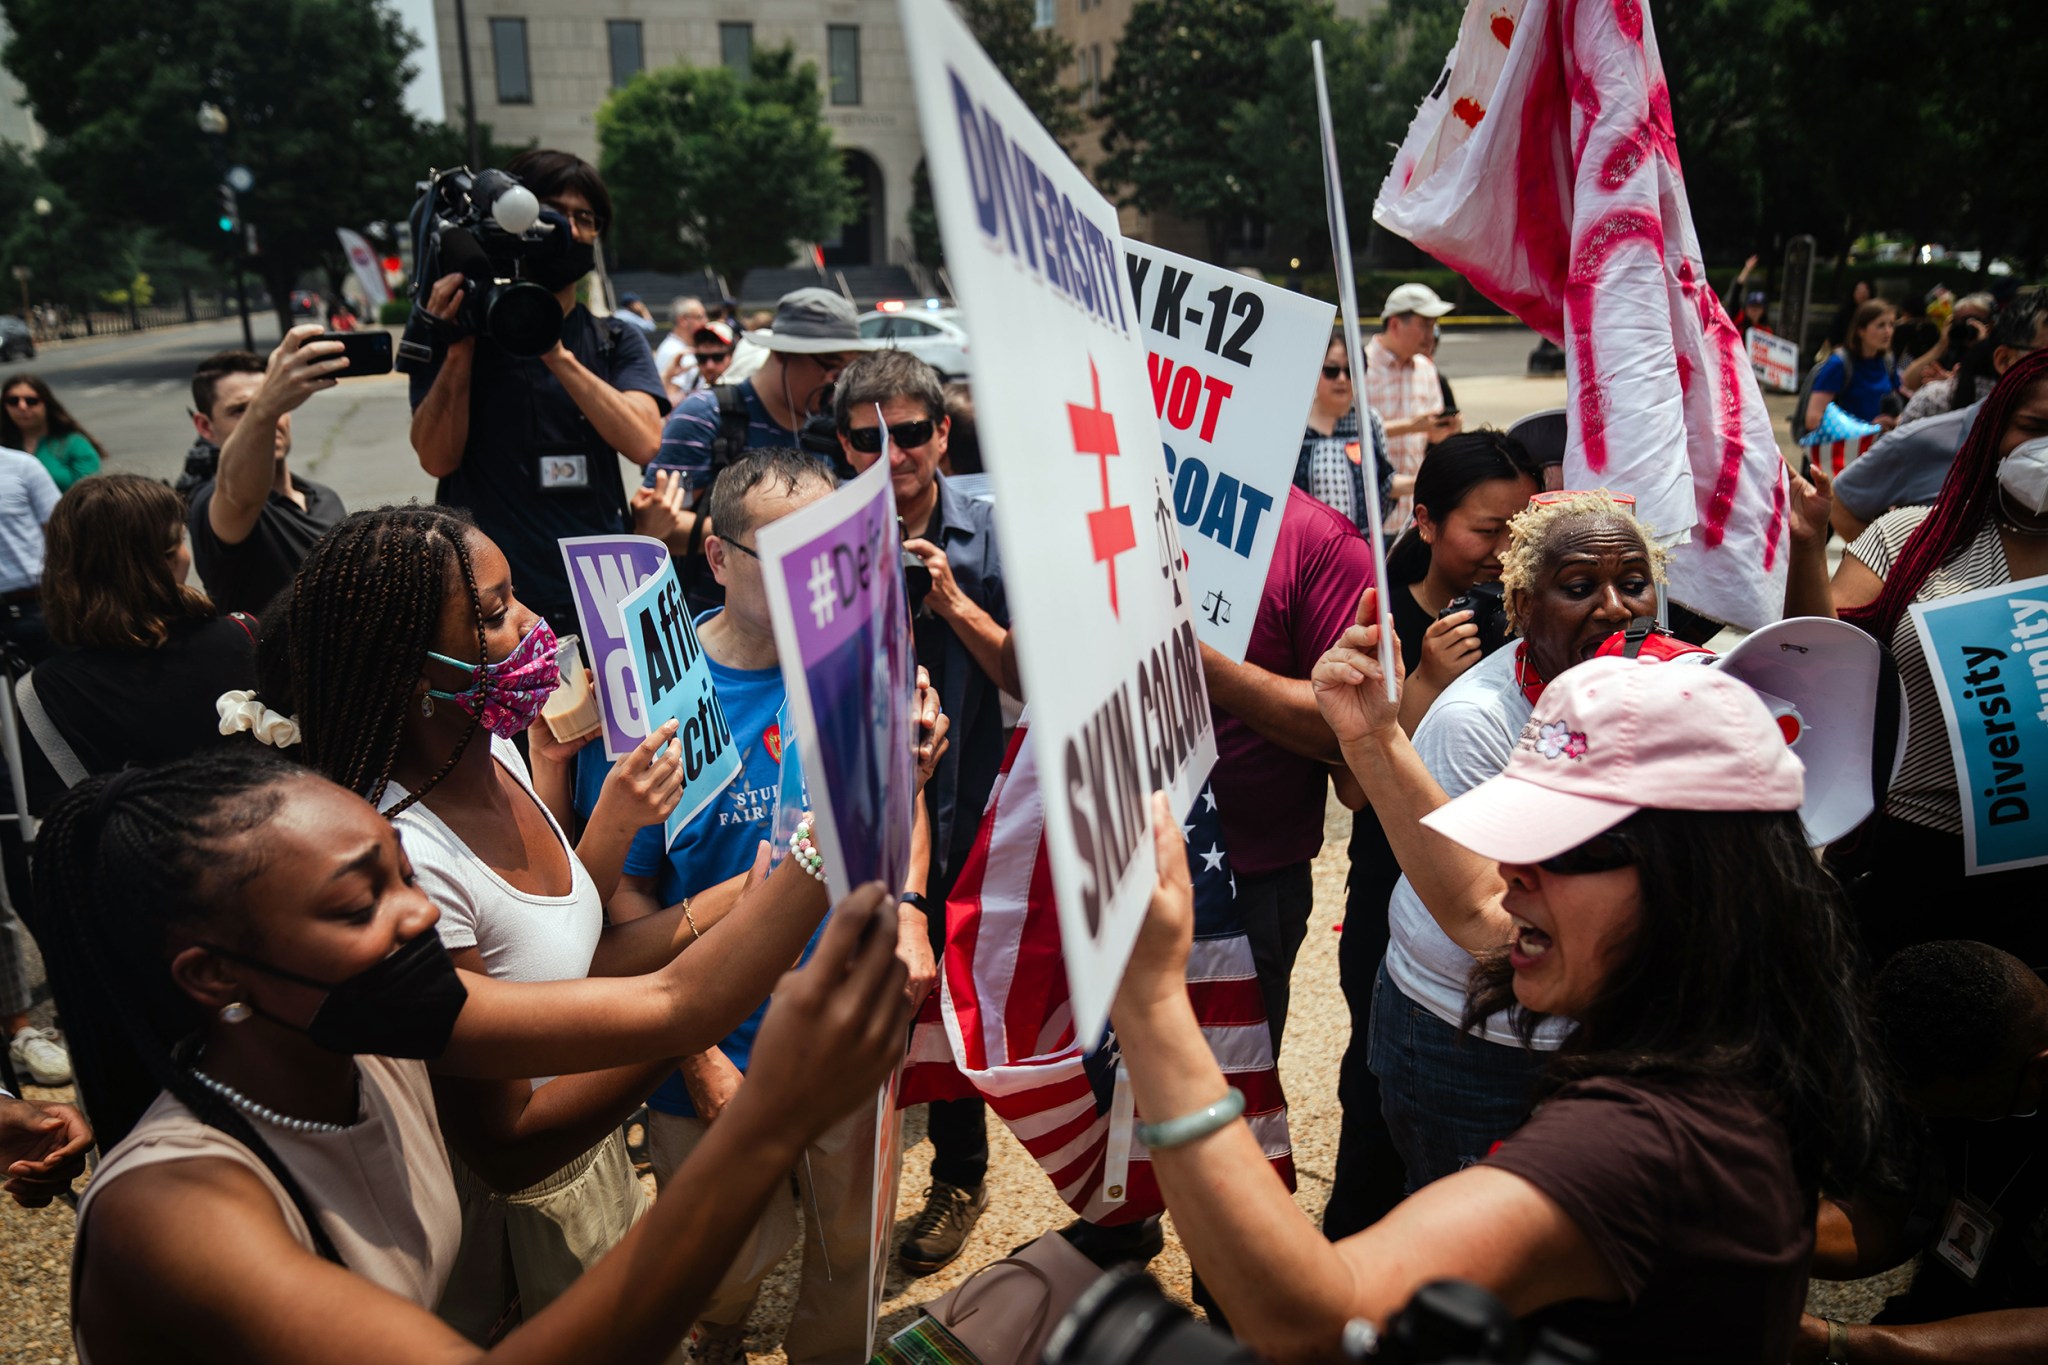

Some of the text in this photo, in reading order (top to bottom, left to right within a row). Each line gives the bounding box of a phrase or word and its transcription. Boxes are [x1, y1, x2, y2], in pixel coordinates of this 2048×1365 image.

[946, 62, 1128, 334] DIVERSITY
[1150, 264, 1265, 368] K-12
[718, 806, 765, 826] FAIR
[1064, 619, 1209, 940] SKIN COLOR
[1961, 646, 2030, 826] Diversity
